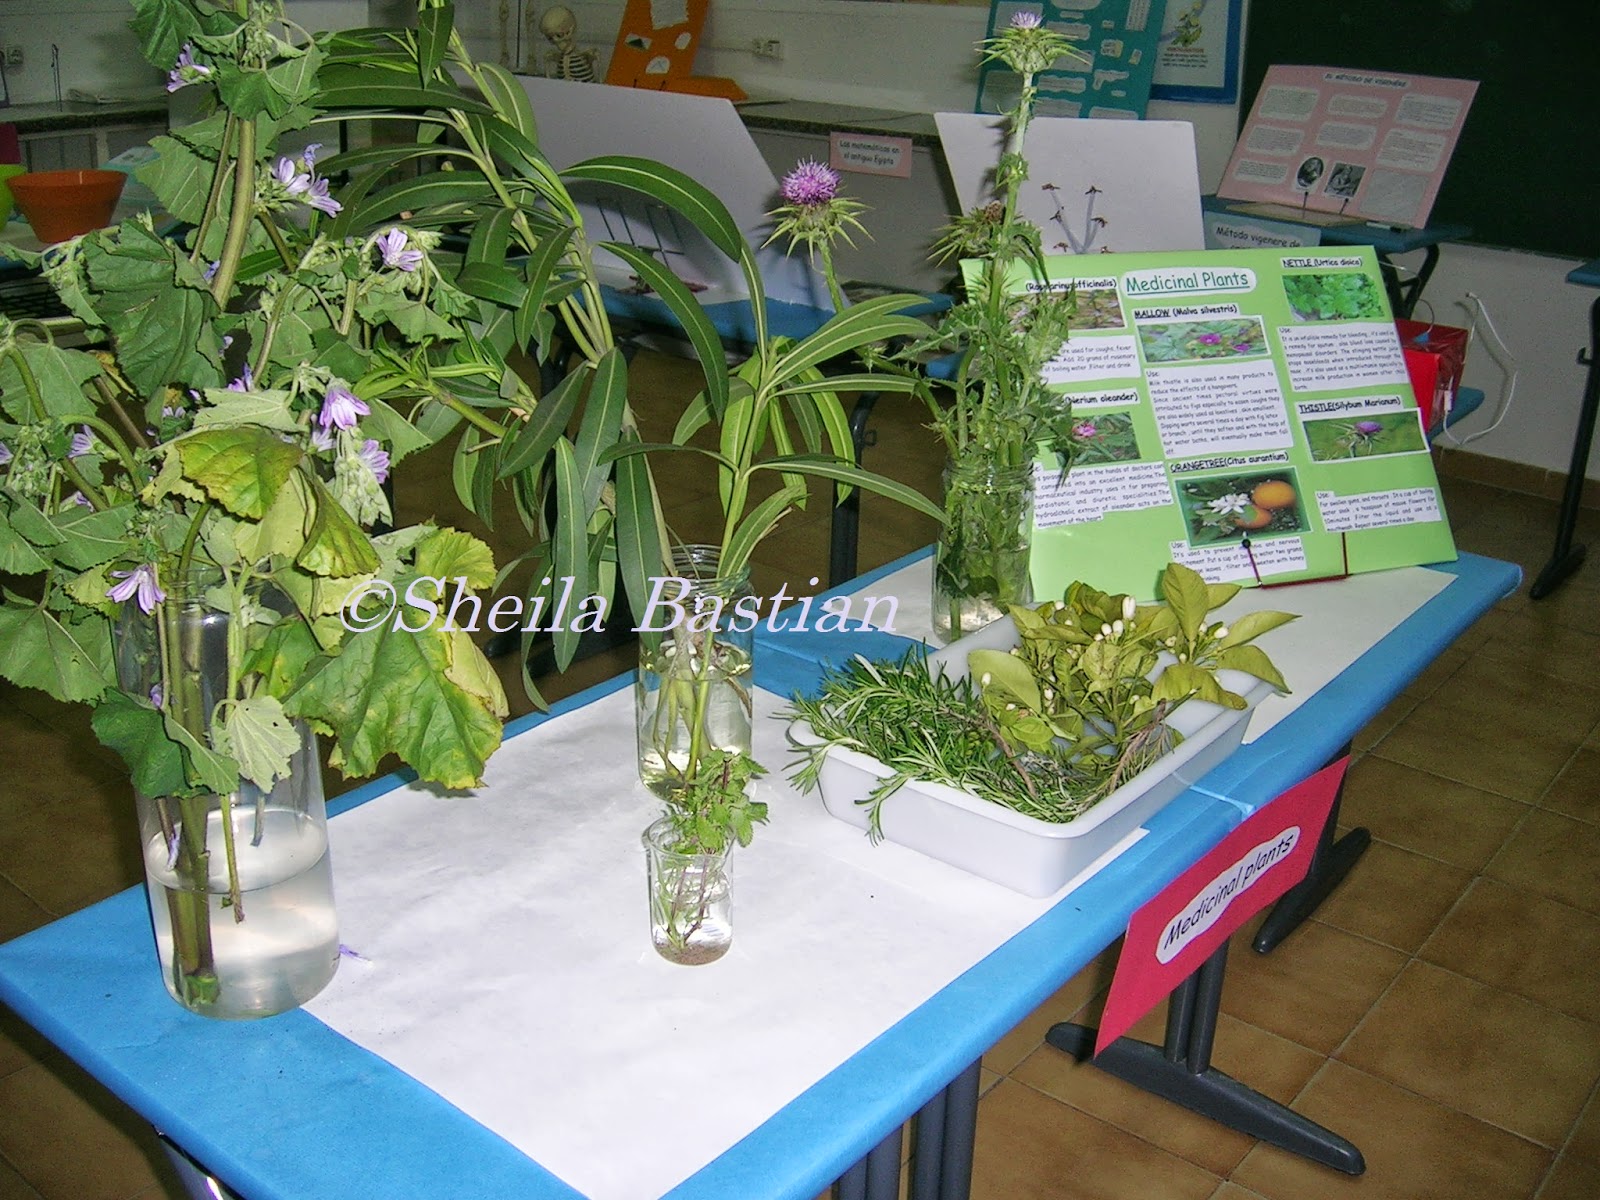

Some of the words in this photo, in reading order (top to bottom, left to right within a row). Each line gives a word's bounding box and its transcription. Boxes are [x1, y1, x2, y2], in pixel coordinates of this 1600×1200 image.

[1216, 227, 1248, 239] Método
[1251, 234, 1287, 247] vigenere
[1283, 259, 1312, 267] NETTLE
[1126, 273, 1197, 292] Medicinal
[1202, 272, 1248, 287] Plants
[1134, 309, 1170, 318] MALLOW
[1173, 307, 1198, 316] (Malva
[1201, 304, 1238, 314] silvestris)
[1101, 392, 1138, 402] oleander)
[1365, 396, 1400, 407] Marianum)
[1249, 452, 1288, 463] aurantium)
[1164, 866, 1243, 950] Medicinal
[1242, 835, 1293, 888] plants
